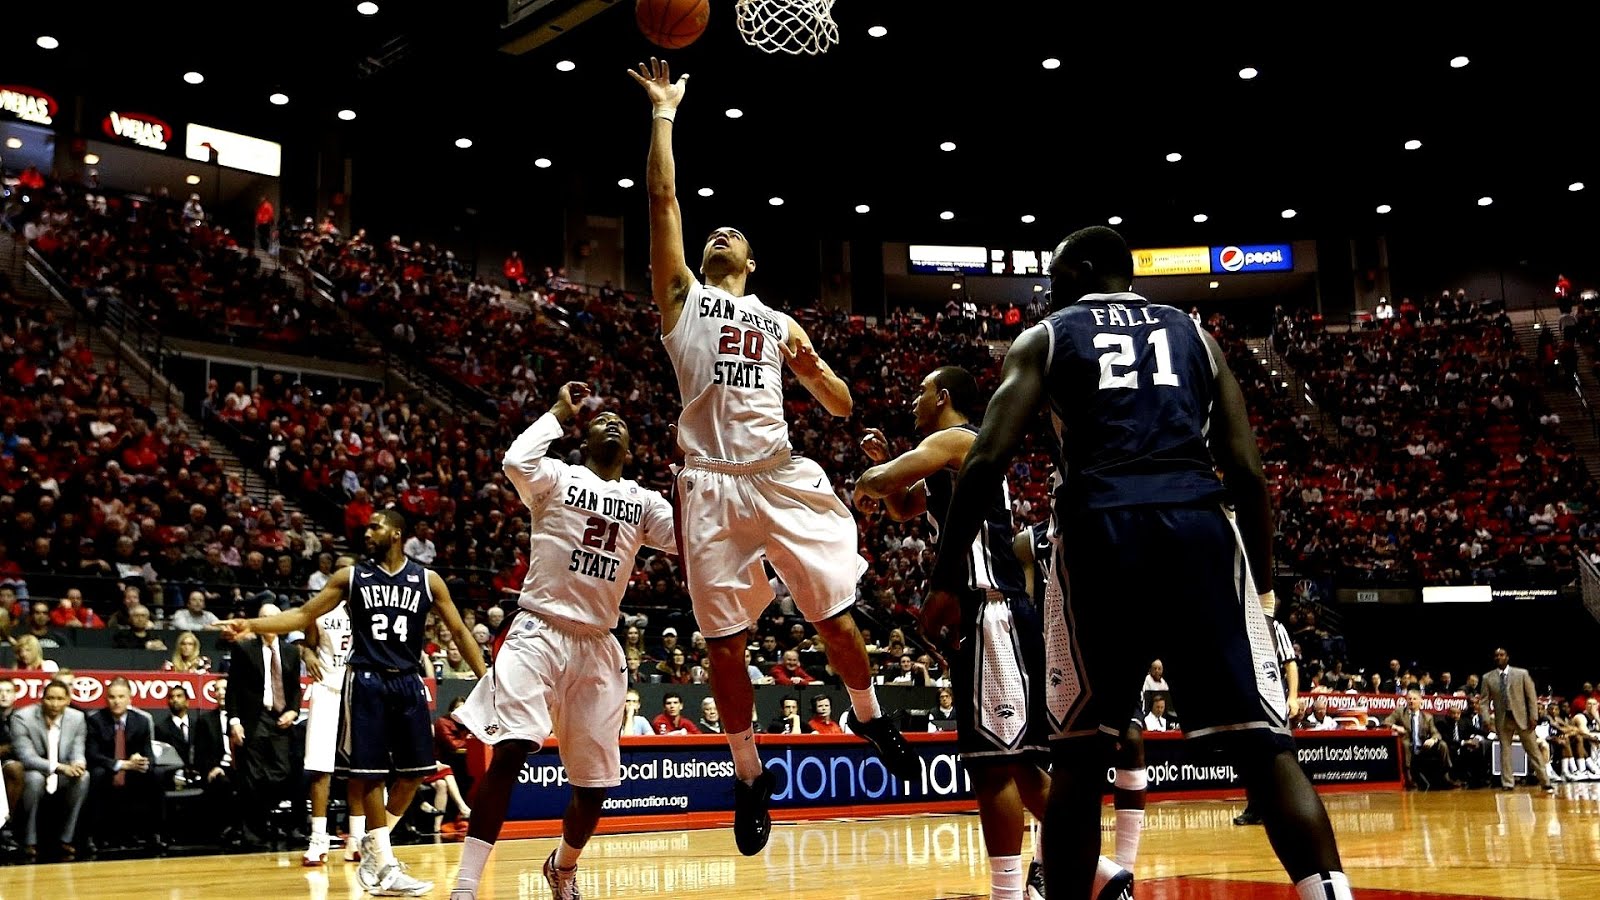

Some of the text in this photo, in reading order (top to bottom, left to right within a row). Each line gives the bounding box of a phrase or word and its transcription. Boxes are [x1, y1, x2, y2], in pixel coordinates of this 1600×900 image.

[1245, 249, 1284, 266] pepsi
[699, 296, 735, 321] SAN
[1090, 307, 1160, 327] FALL
[718, 324, 765, 362] 20
[1092, 328, 1180, 390] 21
[713, 360, 765, 389] STATE
[564, 485, 642, 526] SAN DIEGO
[582, 516, 620, 553] 21
[568, 549, 620, 582] STATE
[360, 585, 421, 614] NEVADA
[323, 617, 342, 630] SAN
[371, 613, 408, 643] 24
[1328, 695, 1357, 710] TOYOTA
[1368, 696, 1396, 710] TOYOTA
[1297, 745, 1389, 764] pport Local Schools
[517, 758, 735, 787] Supp ocal Business
